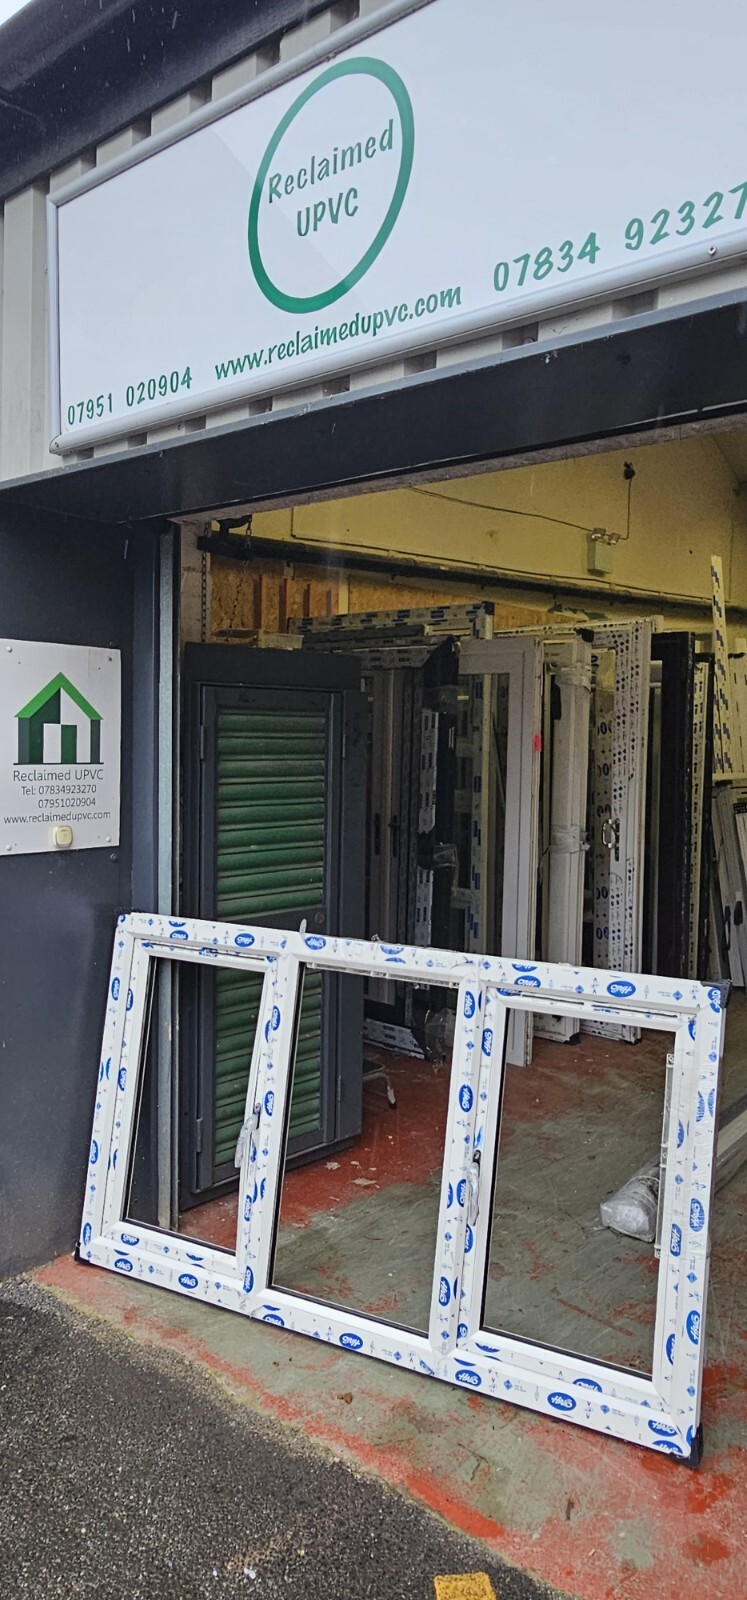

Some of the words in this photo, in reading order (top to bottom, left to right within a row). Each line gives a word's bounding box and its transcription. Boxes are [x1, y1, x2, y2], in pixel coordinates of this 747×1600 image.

[267, 119, 394, 204] Reclaimed
[296, 187, 359, 237] UPVC
[67, 393, 113, 426] 07951
[126, 366, 193, 408] 020904
[214, 287, 462, 381] www.reclaimedupvc.com
[493, 231, 601, 292] 07834
[13, 769, 71, 782] Reclaimed
[75, 769, 104, 780] UPVC
[21, 785, 36, 796] Tel:
[38, 784, 97, 795] 07834923270
[38, 798, 96, 809] 07951020904
[3, 811, 111, 825] www.reclaimedupvc.com
